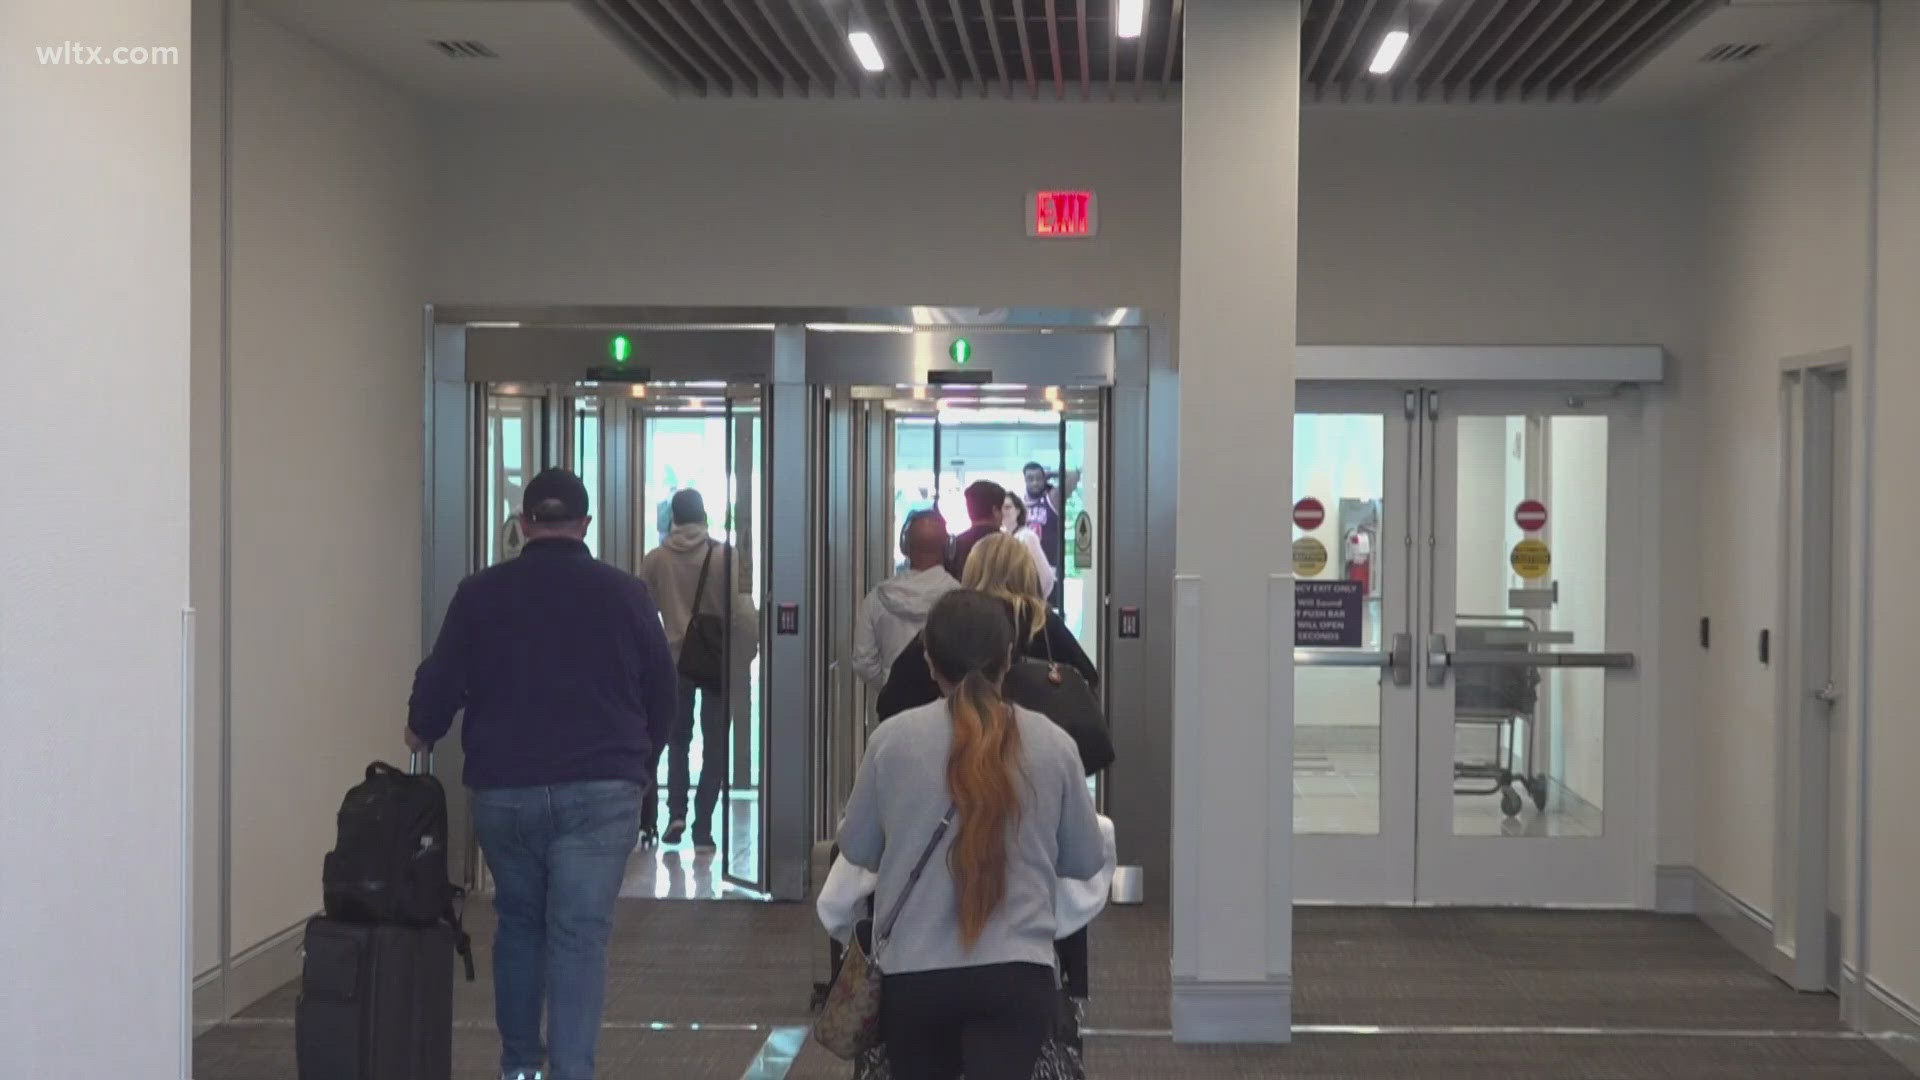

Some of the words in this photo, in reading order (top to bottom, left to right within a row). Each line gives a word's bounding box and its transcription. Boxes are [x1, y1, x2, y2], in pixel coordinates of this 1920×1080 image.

[1037, 191, 1090, 233] EXIT
[1312, 584, 1331, 593] EXIT
[1333, 584, 1357, 593] ONLY
[1302, 610, 1326, 618] PUSH
[1327, 610, 1345, 618] BAR
[1297, 621, 1318, 630] WILL
[1319, 621, 1345, 630] OPEN
[1297, 632, 1339, 640] SECONDS
